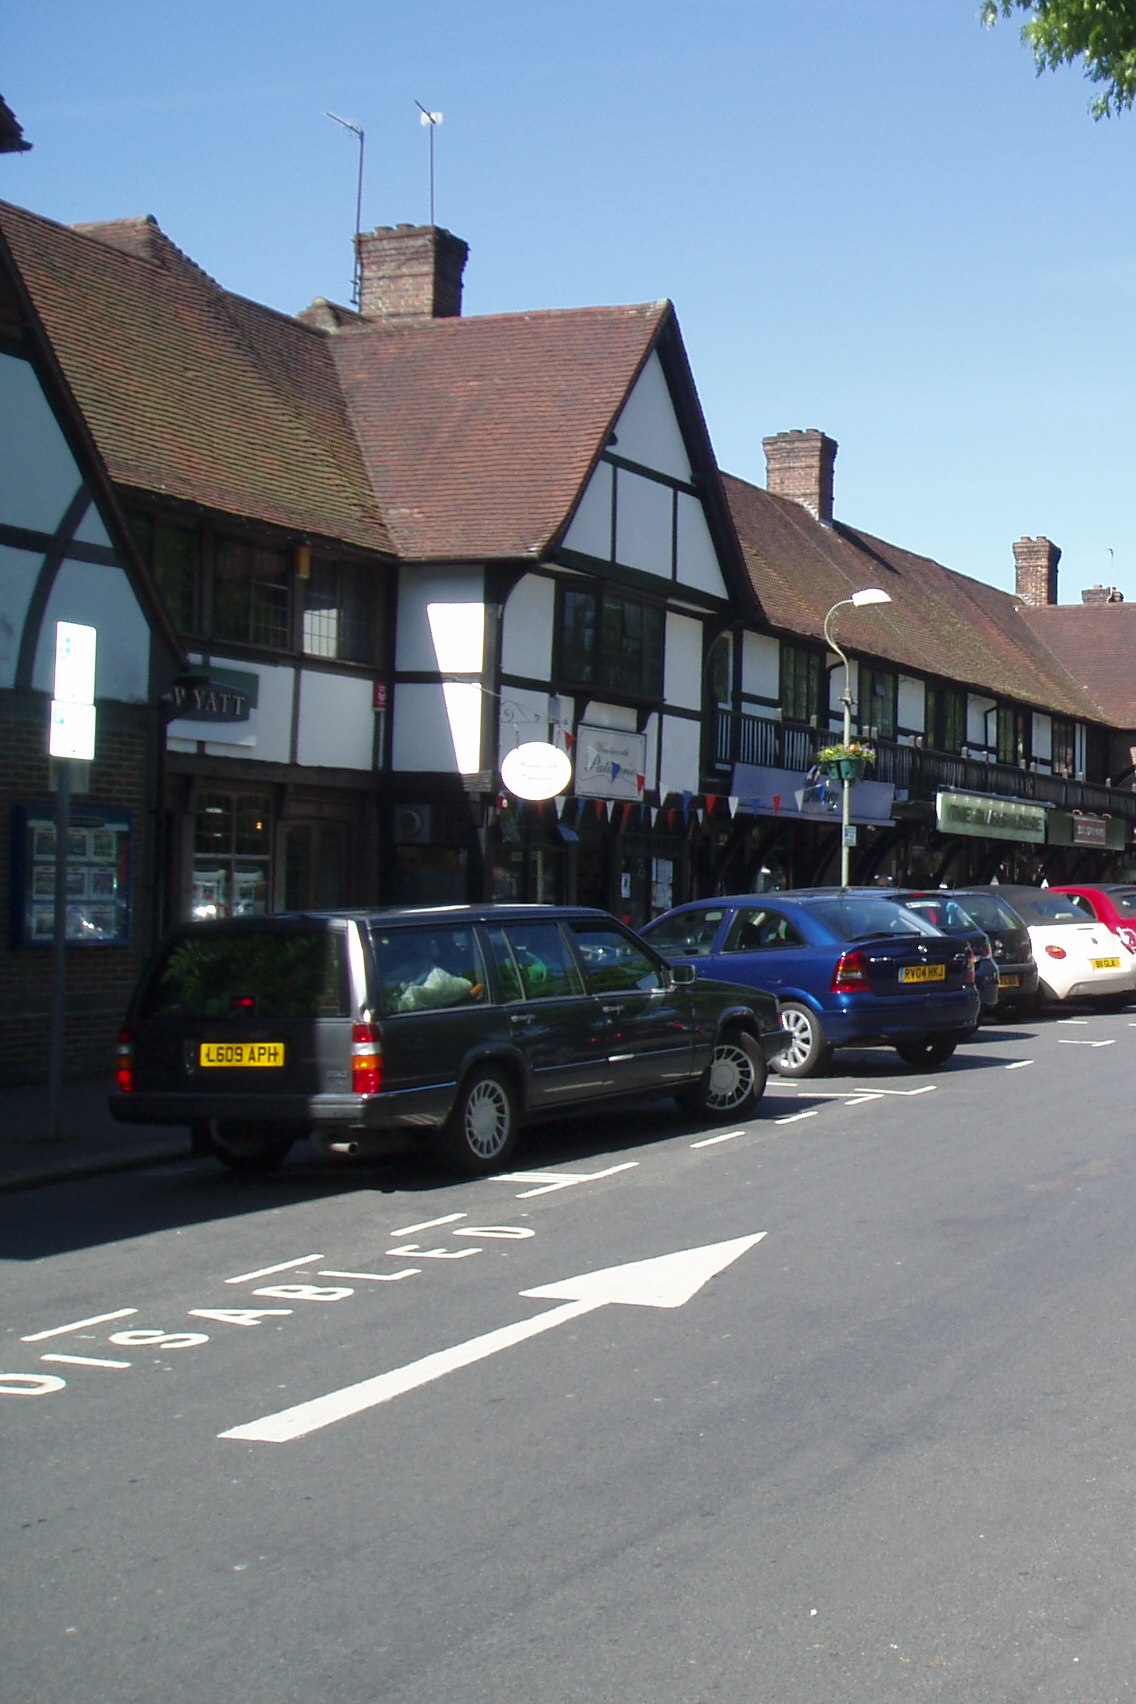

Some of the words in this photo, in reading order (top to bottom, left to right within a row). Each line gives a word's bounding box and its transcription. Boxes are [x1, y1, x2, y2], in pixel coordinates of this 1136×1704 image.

[904, 966, 926, 981] RV04
[207, 1046, 243, 1063] L609
[249, 1046, 279, 1062] APH
[0, 1226, 535, 1395] DISABLED
